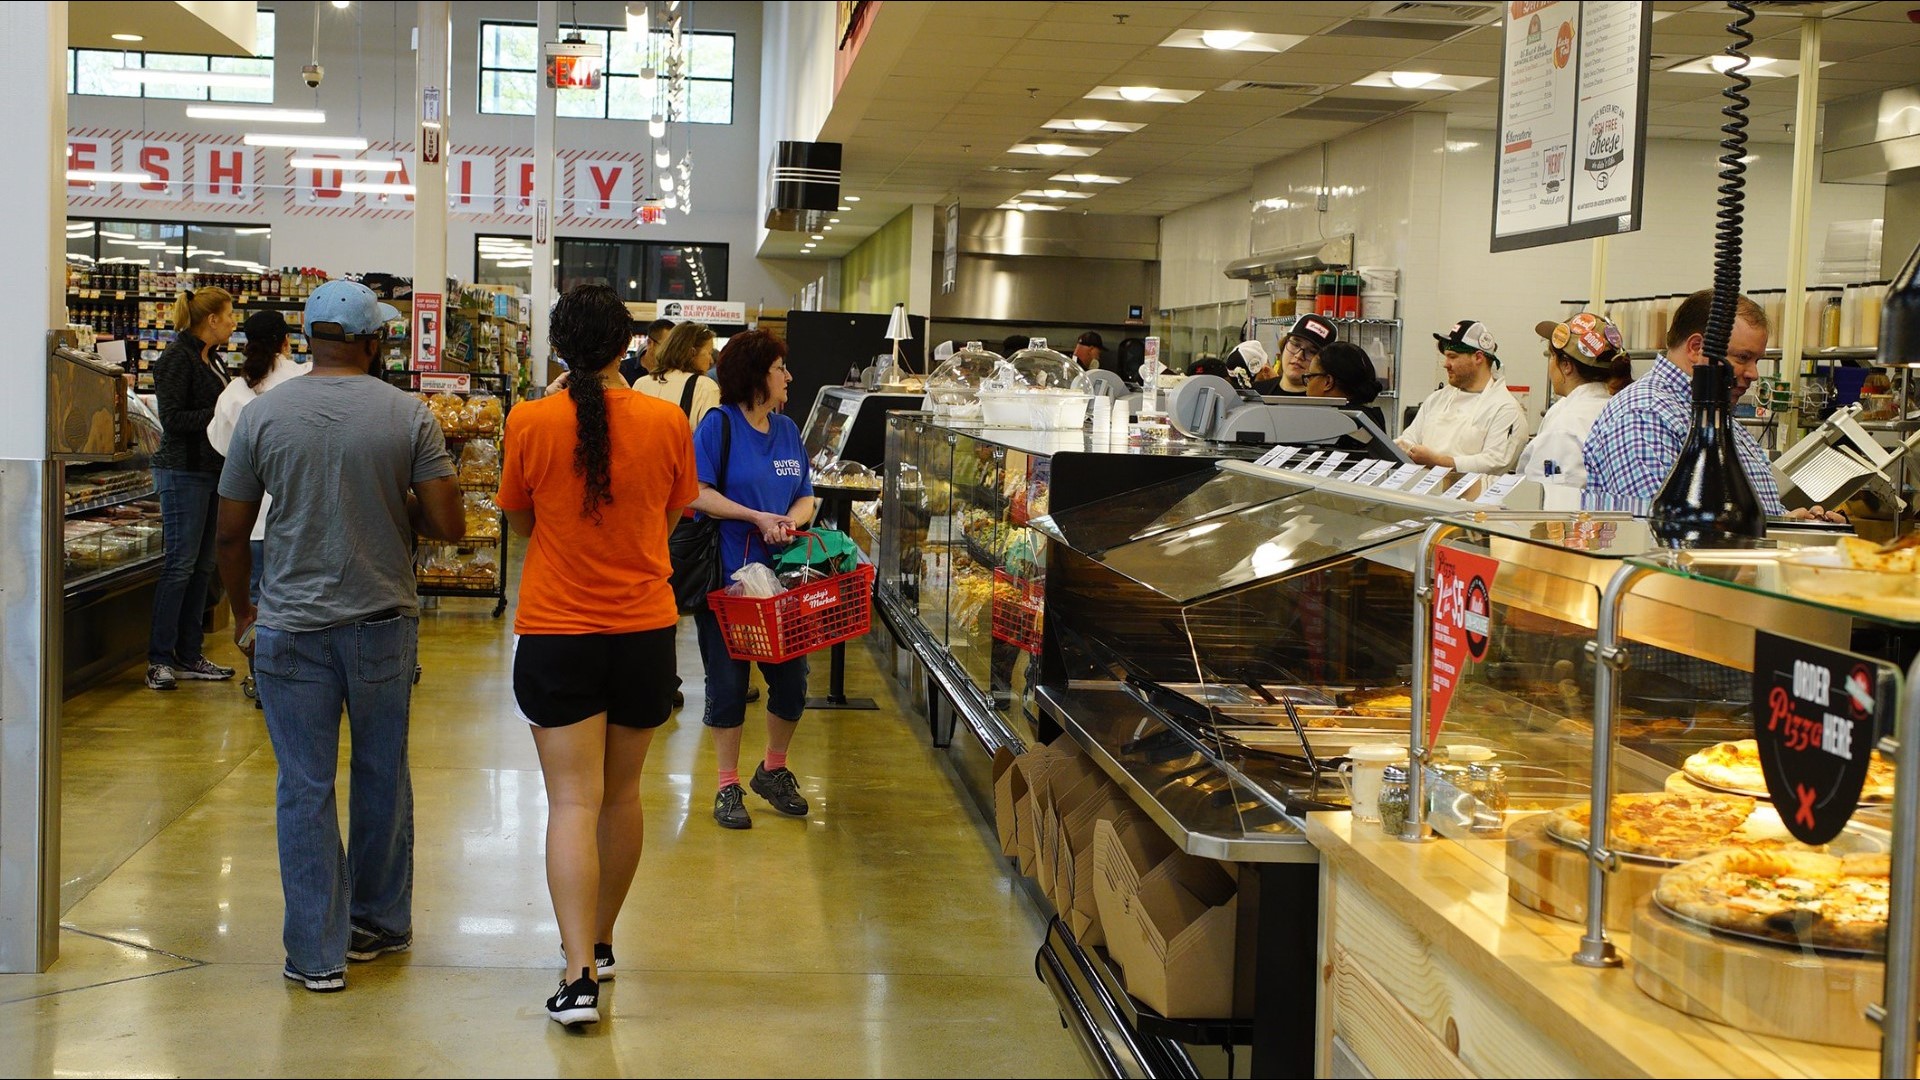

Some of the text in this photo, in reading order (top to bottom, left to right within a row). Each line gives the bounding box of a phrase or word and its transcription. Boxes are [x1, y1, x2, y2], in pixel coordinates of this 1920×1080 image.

[556, 57, 591, 86] EX
[1590, 130, 1620, 156] cheese
[706, 311, 740, 319] FARMERS
[809, 595, 837, 609] Market
[1436, 573, 1444, 620] 2
[1451, 575, 1465, 629] $5
[1793, 659, 1831, 707] ORDER
[1767, 687, 1854, 761] Pizza HERE
[575, 995, 595, 1006] NIKE
